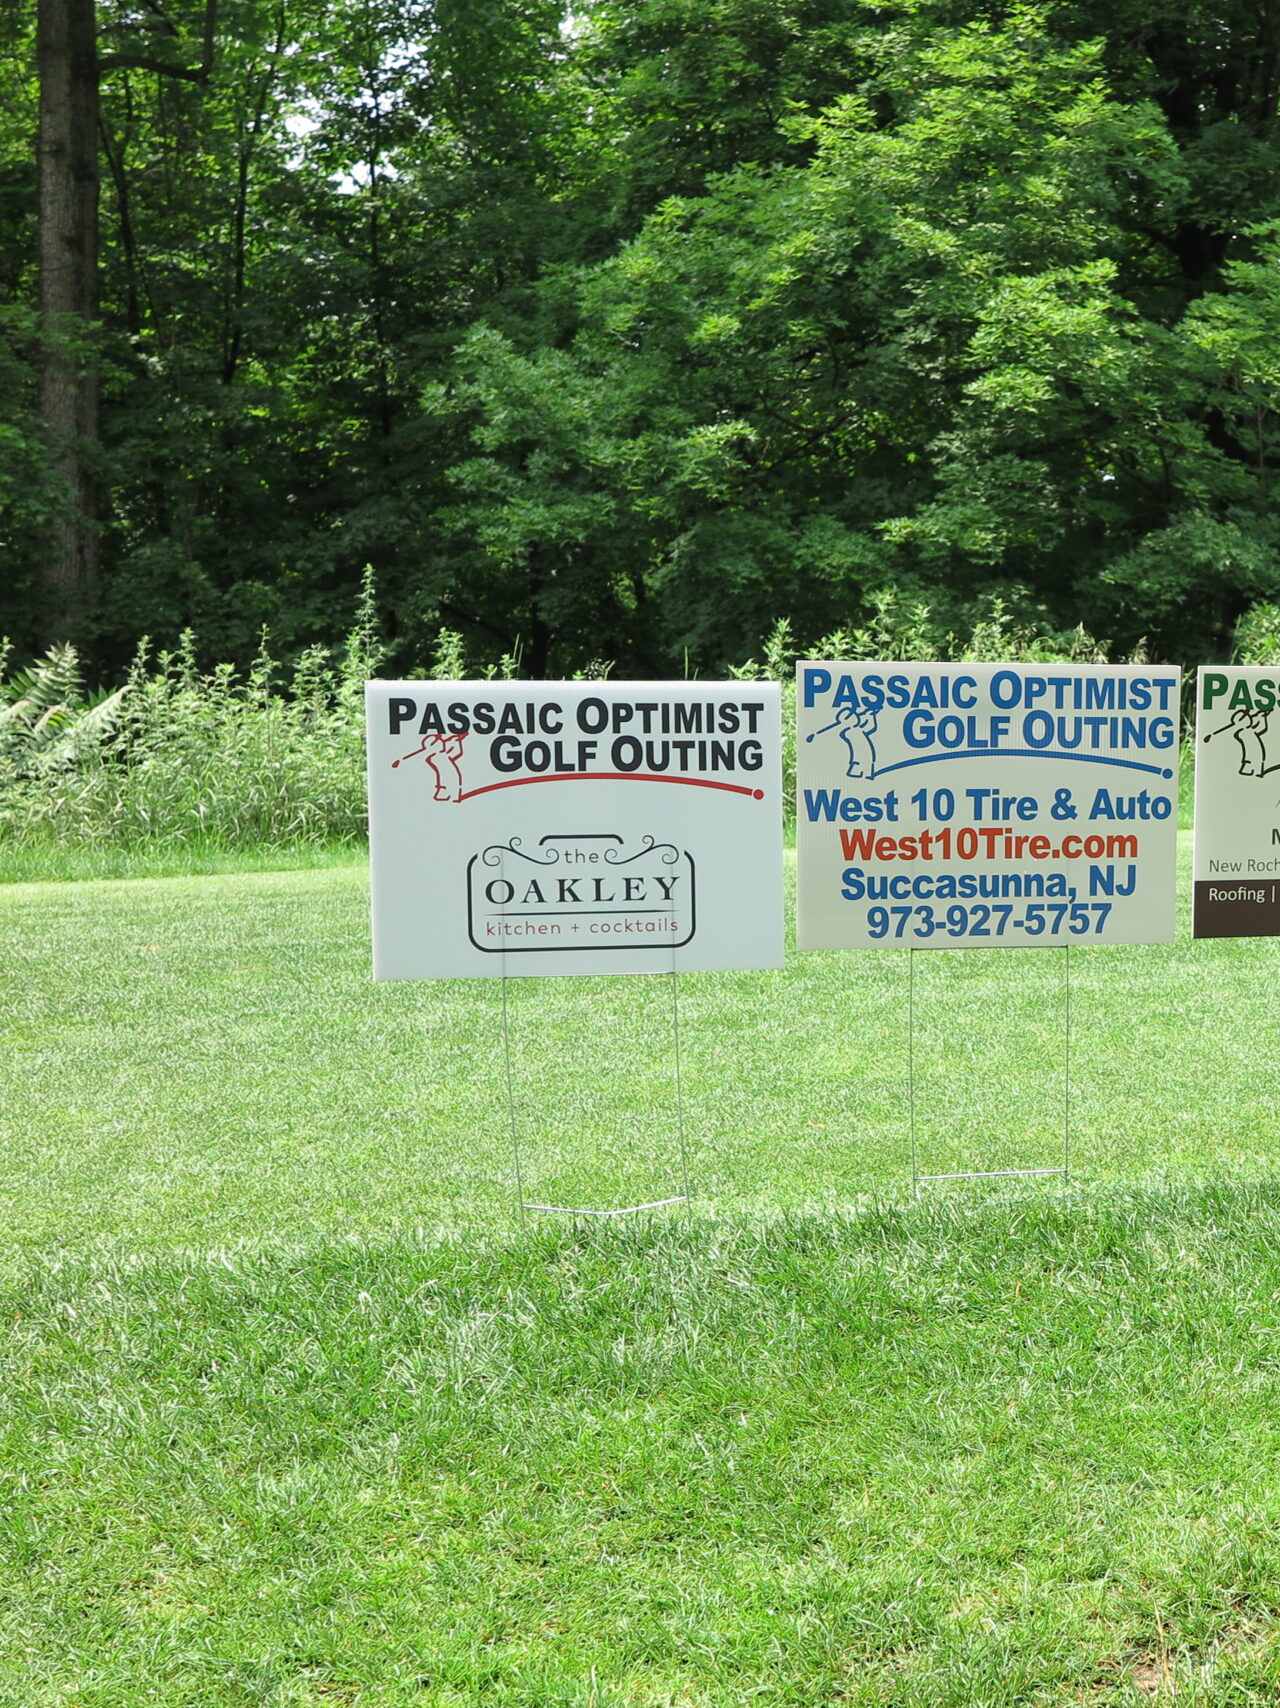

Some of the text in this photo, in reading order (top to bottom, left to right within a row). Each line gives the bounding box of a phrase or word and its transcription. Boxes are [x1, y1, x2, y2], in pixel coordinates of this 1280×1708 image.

[804, 669, 1176, 710] PASSAIC OPTIMIST
[389, 697, 764, 735] PASSAIC OPTIMIST
[903, 710, 1174, 749] GOLF OUTING
[490, 736, 763, 772] GOLF OUTING
[804, 788, 1172, 822] West 10 Tire & Auto
[565, 849, 599, 864] the
[840, 828, 1138, 861] West10Tire.com
[1209, 859, 1242, 873] New
[485, 876, 680, 904] OAKLEY
[841, 865, 1136, 904] Succasunna, NJ
[1209, 887, 1265, 903] Roofing
[487, 918, 678, 936] kitchen + cocktails
[867, 903, 1112, 938] 973-927-5757
